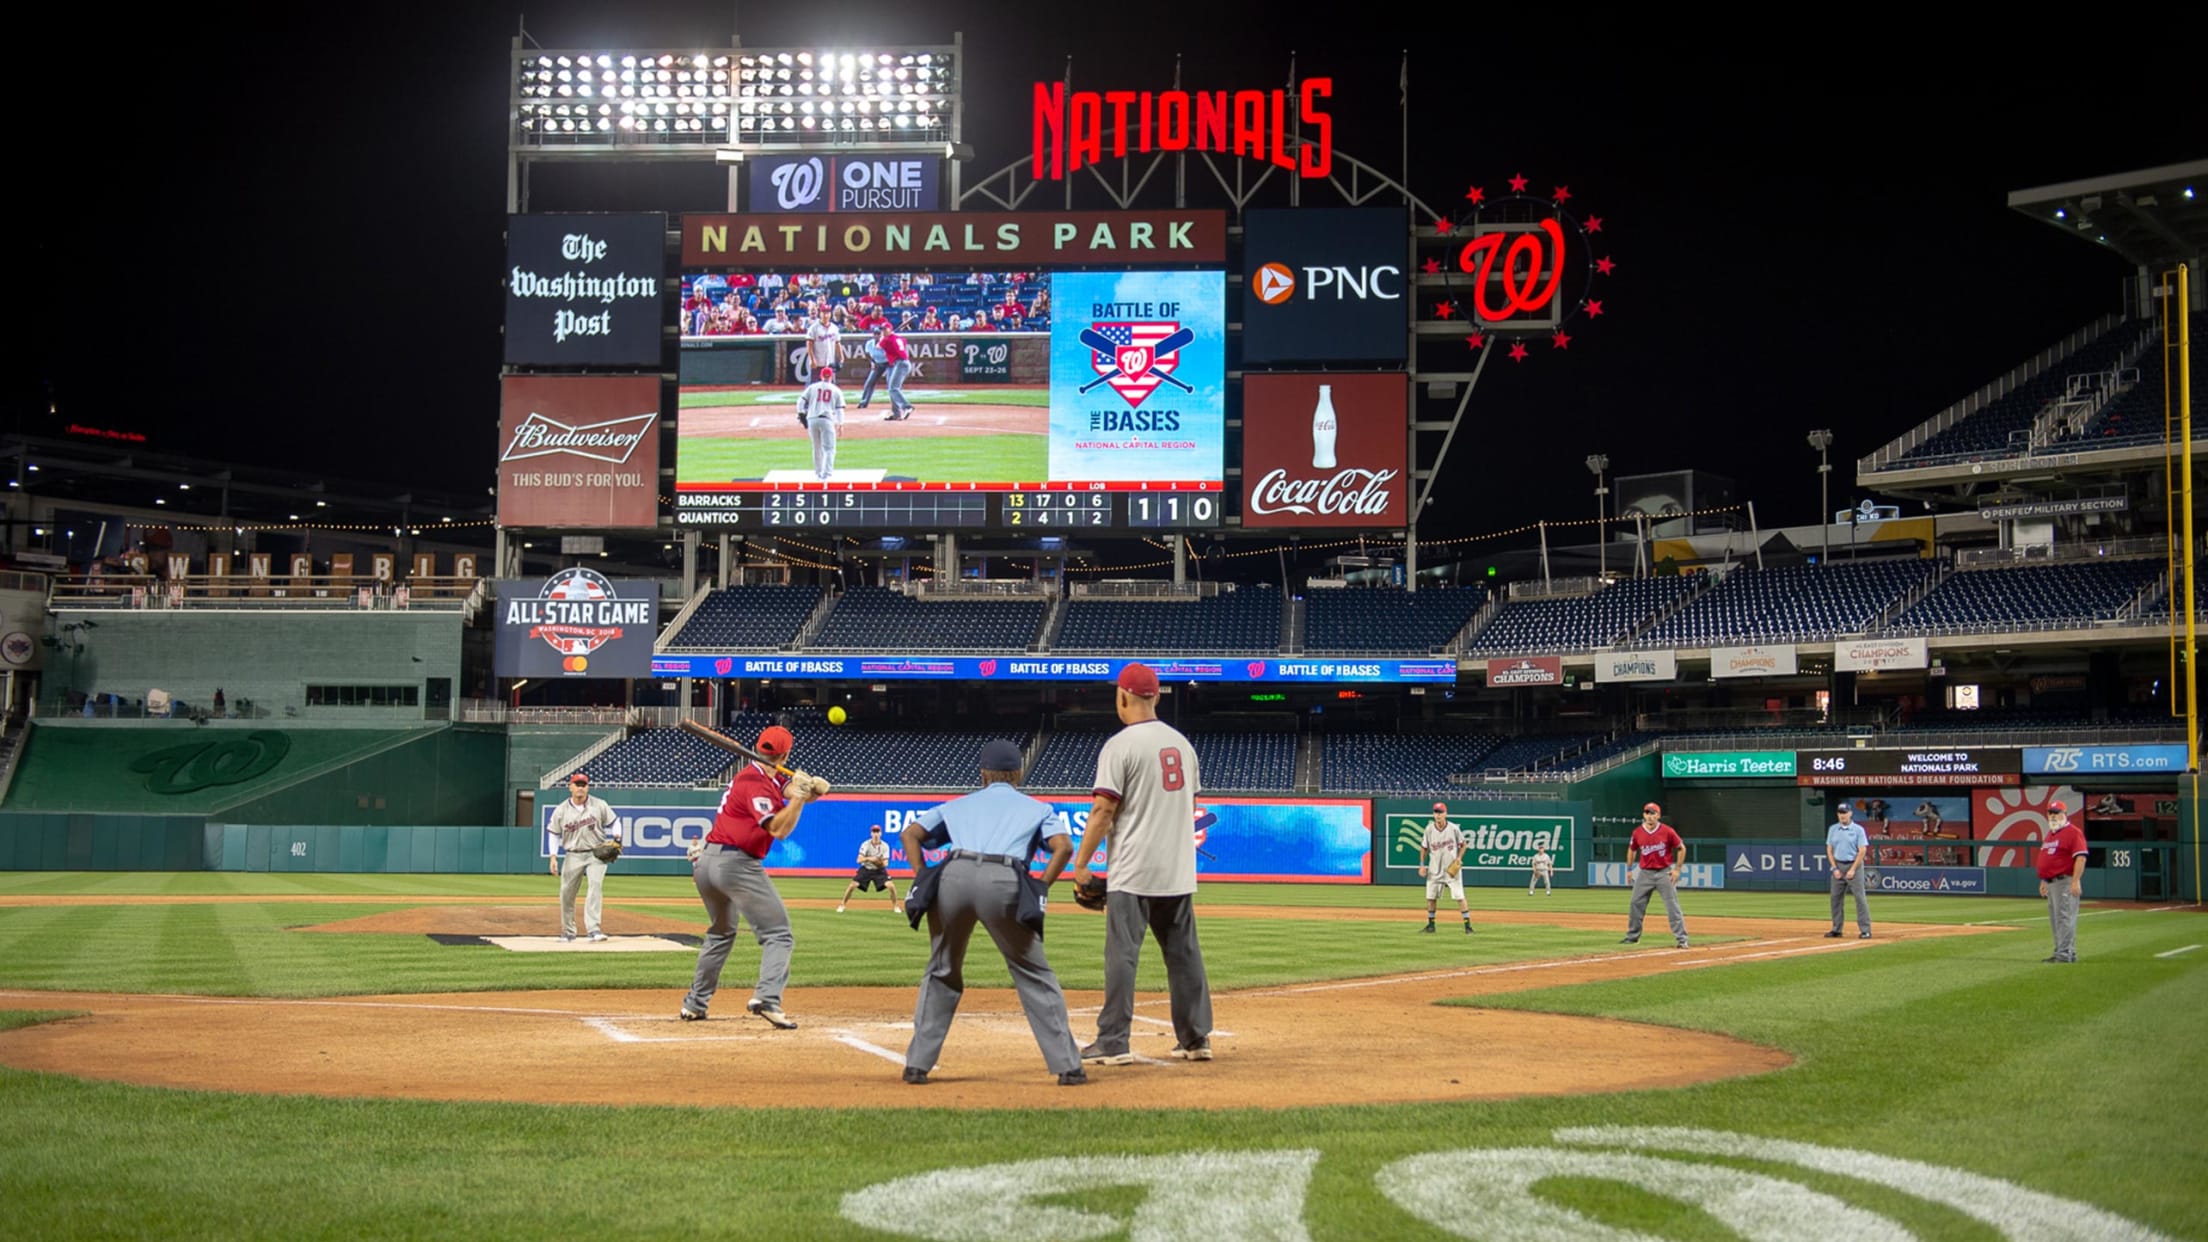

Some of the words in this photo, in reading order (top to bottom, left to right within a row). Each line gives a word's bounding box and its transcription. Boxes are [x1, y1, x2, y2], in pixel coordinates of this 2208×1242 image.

[1032, 77, 1332, 180] NATIONALS
[843, 161, 922, 188] ONE
[842, 188, 922, 208] PURSUIT
[702, 224, 1020, 252] NATIONALS
[1054, 222, 1194, 249] PARK
[562, 234, 608, 264] The
[1459, 217, 1565, 322] W
[510, 265, 657, 304] Washington
[1302, 265, 1400, 300] PNC
[1092, 302, 1153, 318] BATTLE
[1159, 302, 1180, 318] OF
[553, 309, 611, 343] Post
[817, 388, 832, 403] 10
[1090, 410, 1101, 432] THE
[1103, 410, 1180, 431] BASES
[515, 424, 640, 448] Budweiser
[1075, 441, 1120, 449] NATIONAL
[1122, 441, 1159, 449] CAPITAL
[1161, 440, 1196, 448] REGION
[512, 473, 542, 487] THIS
[544, 473, 583, 487] BUD'S
[586, 473, 612, 487] FOR
[615, 473, 645, 487] YOU.
[847, 482, 853, 490] 4
[896, 482, 902, 490] 6
[920, 482, 926, 490] 7
[1041, 482, 1048, 490] H
[1067, 482, 1073, 490] E
[1089, 482, 1106, 490] LOB
[1251, 468, 1399, 515] Coca-Cola
[678, 494, 741, 507] BARRACKS
[771, 494, 781, 507] 2
[796, 494, 806, 507] 5
[821, 494, 828, 507] 1
[845, 494, 854, 507] 5
[1009, 494, 1025, 507] 13
[1036, 494, 1051, 507] 17
[1065, 494, 1076, 507] 0
[1092, 494, 1102, 507] 6
[1138, 497, 1149, 520] 1
[1168, 497, 1178, 520] 1
[1194, 497, 1212, 520] 0
[1992, 506, 2030, 518] PENFED
[2034, 503, 2078, 514] MILITARY
[2080, 499, 2124, 510] SECTION
[678, 512, 739, 525] QUANTICO
[771, 511, 781, 524] 2
[794, 511, 806, 524] 0
[819, 511, 830, 524] 0
[1012, 511, 1021, 525] 2
[1038, 512, 1048, 525] 4
[1067, 512, 1073, 524] 1
[1092, 512, 1102, 524] 2
[131, 556, 310, 580] SWING
[375, 557, 473, 581] BIG
[506, 601, 541, 624] ALL
[545, 601, 593, 624] STAR
[598, 602, 649, 624] GAME
[1850, 647, 1910, 659] CHAMPIONS
[745, 661, 783, 672] BATTLE
[785, 661, 799, 672] OF
[807, 661, 844, 673] BASES
[1010, 662, 1048, 674] BATTLE
[1051, 662, 1064, 674] OF
[1072, 663, 1110, 674] BASES
[1279, 664, 1318, 676] BATTLE
[1321, 665, 1335, 676] OF
[1343, 665, 1381, 676] BASES
[1613, 662, 1656, 677] CHAMPIONS
[1493, 673, 1554, 683] CHAMPIONS
[1687, 759, 1737, 774] Harris
[1740, 758, 1792, 773] Teeter
[1812, 757, 1845, 771] 8:46
[1908, 753, 1953, 763] WELCOME
[1955, 753, 1968, 762] TO
[2044, 748, 2083, 772] RTS
[2092, 752, 2168, 769] RTS.com
[1159, 746, 1184, 792] 8
[1901, 763, 1952, 772] NATIONALS
[1953, 763, 1978, 772] PARK
[1813, 776, 1866, 785] WASHINGTON
[1868, 776, 1914, 785] NATIONALS
[1916, 775, 1946, 784] DREAM
[1949, 775, 2004, 784] FOUNDATION
[1458, 824, 1562, 850] ational
[290, 841, 307, 857] 402
[1478, 853, 1504, 865] Car
[1761, 854, 1834, 871] DELT
[2112, 850, 2131, 868] 335
[1882, 876, 1931, 890] Choose
[1951, 880, 1977, 888] va.gov
